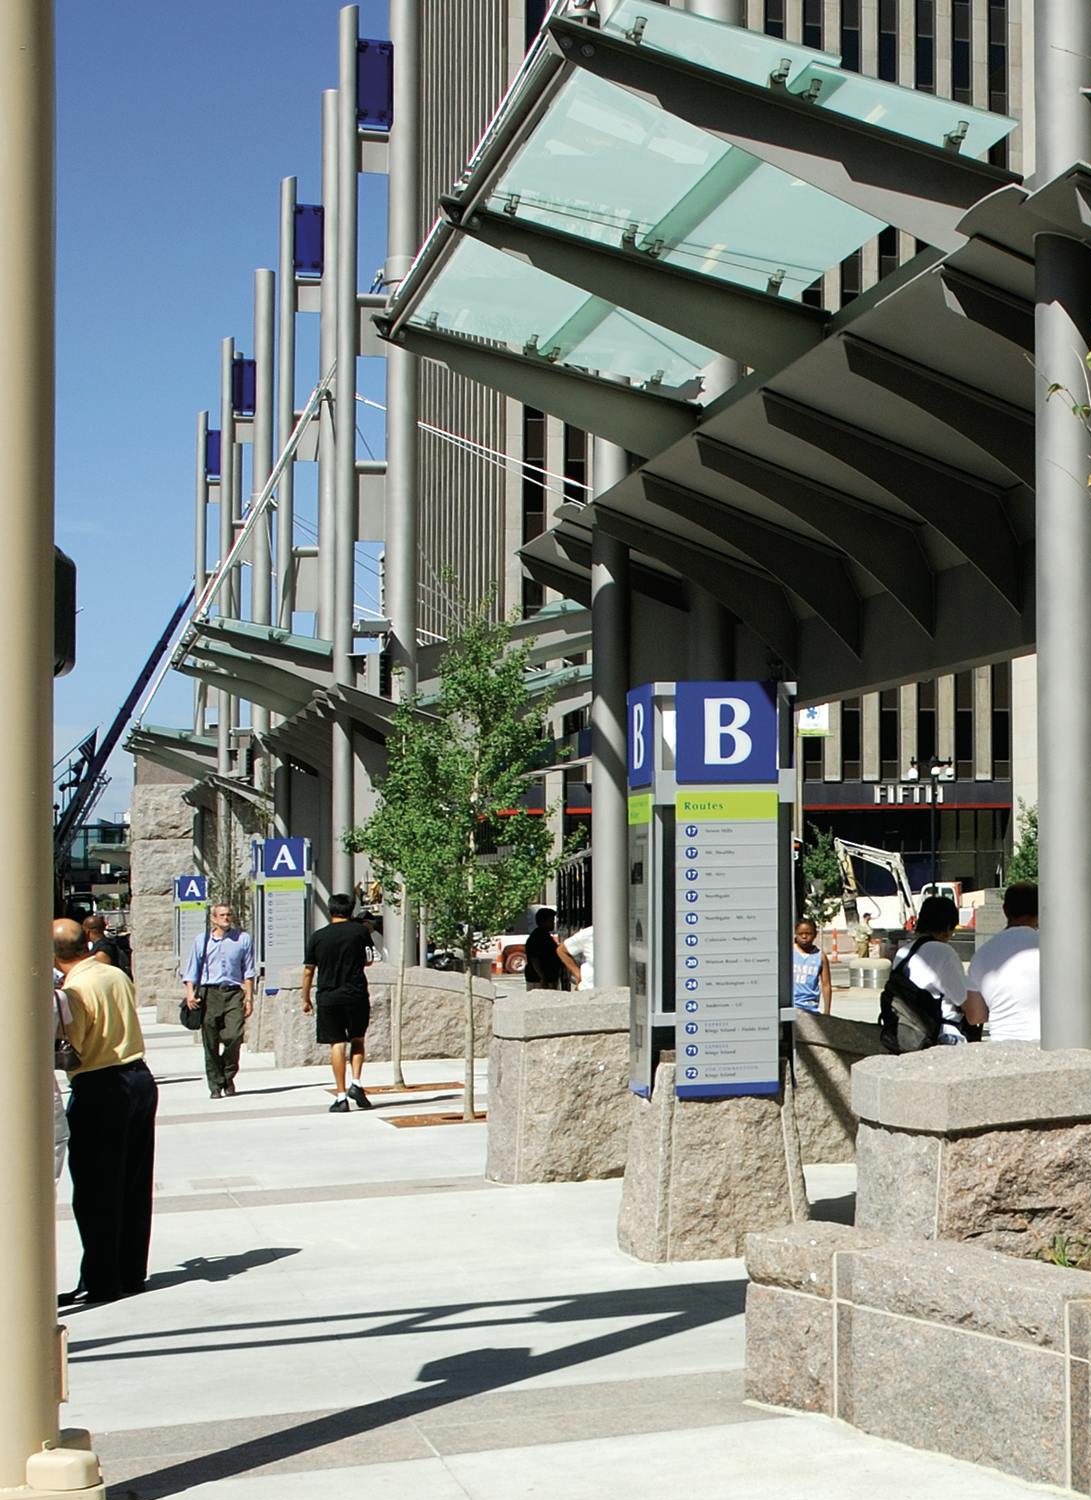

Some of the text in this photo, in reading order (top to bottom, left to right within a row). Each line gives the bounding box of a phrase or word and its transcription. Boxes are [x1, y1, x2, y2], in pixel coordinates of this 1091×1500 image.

[633, 703, 645, 770] B
[704, 698, 752, 765] B
[684, 801, 724, 811] Routes
[272, 844, 297, 871] A
[185, 879, 201, 897] A
